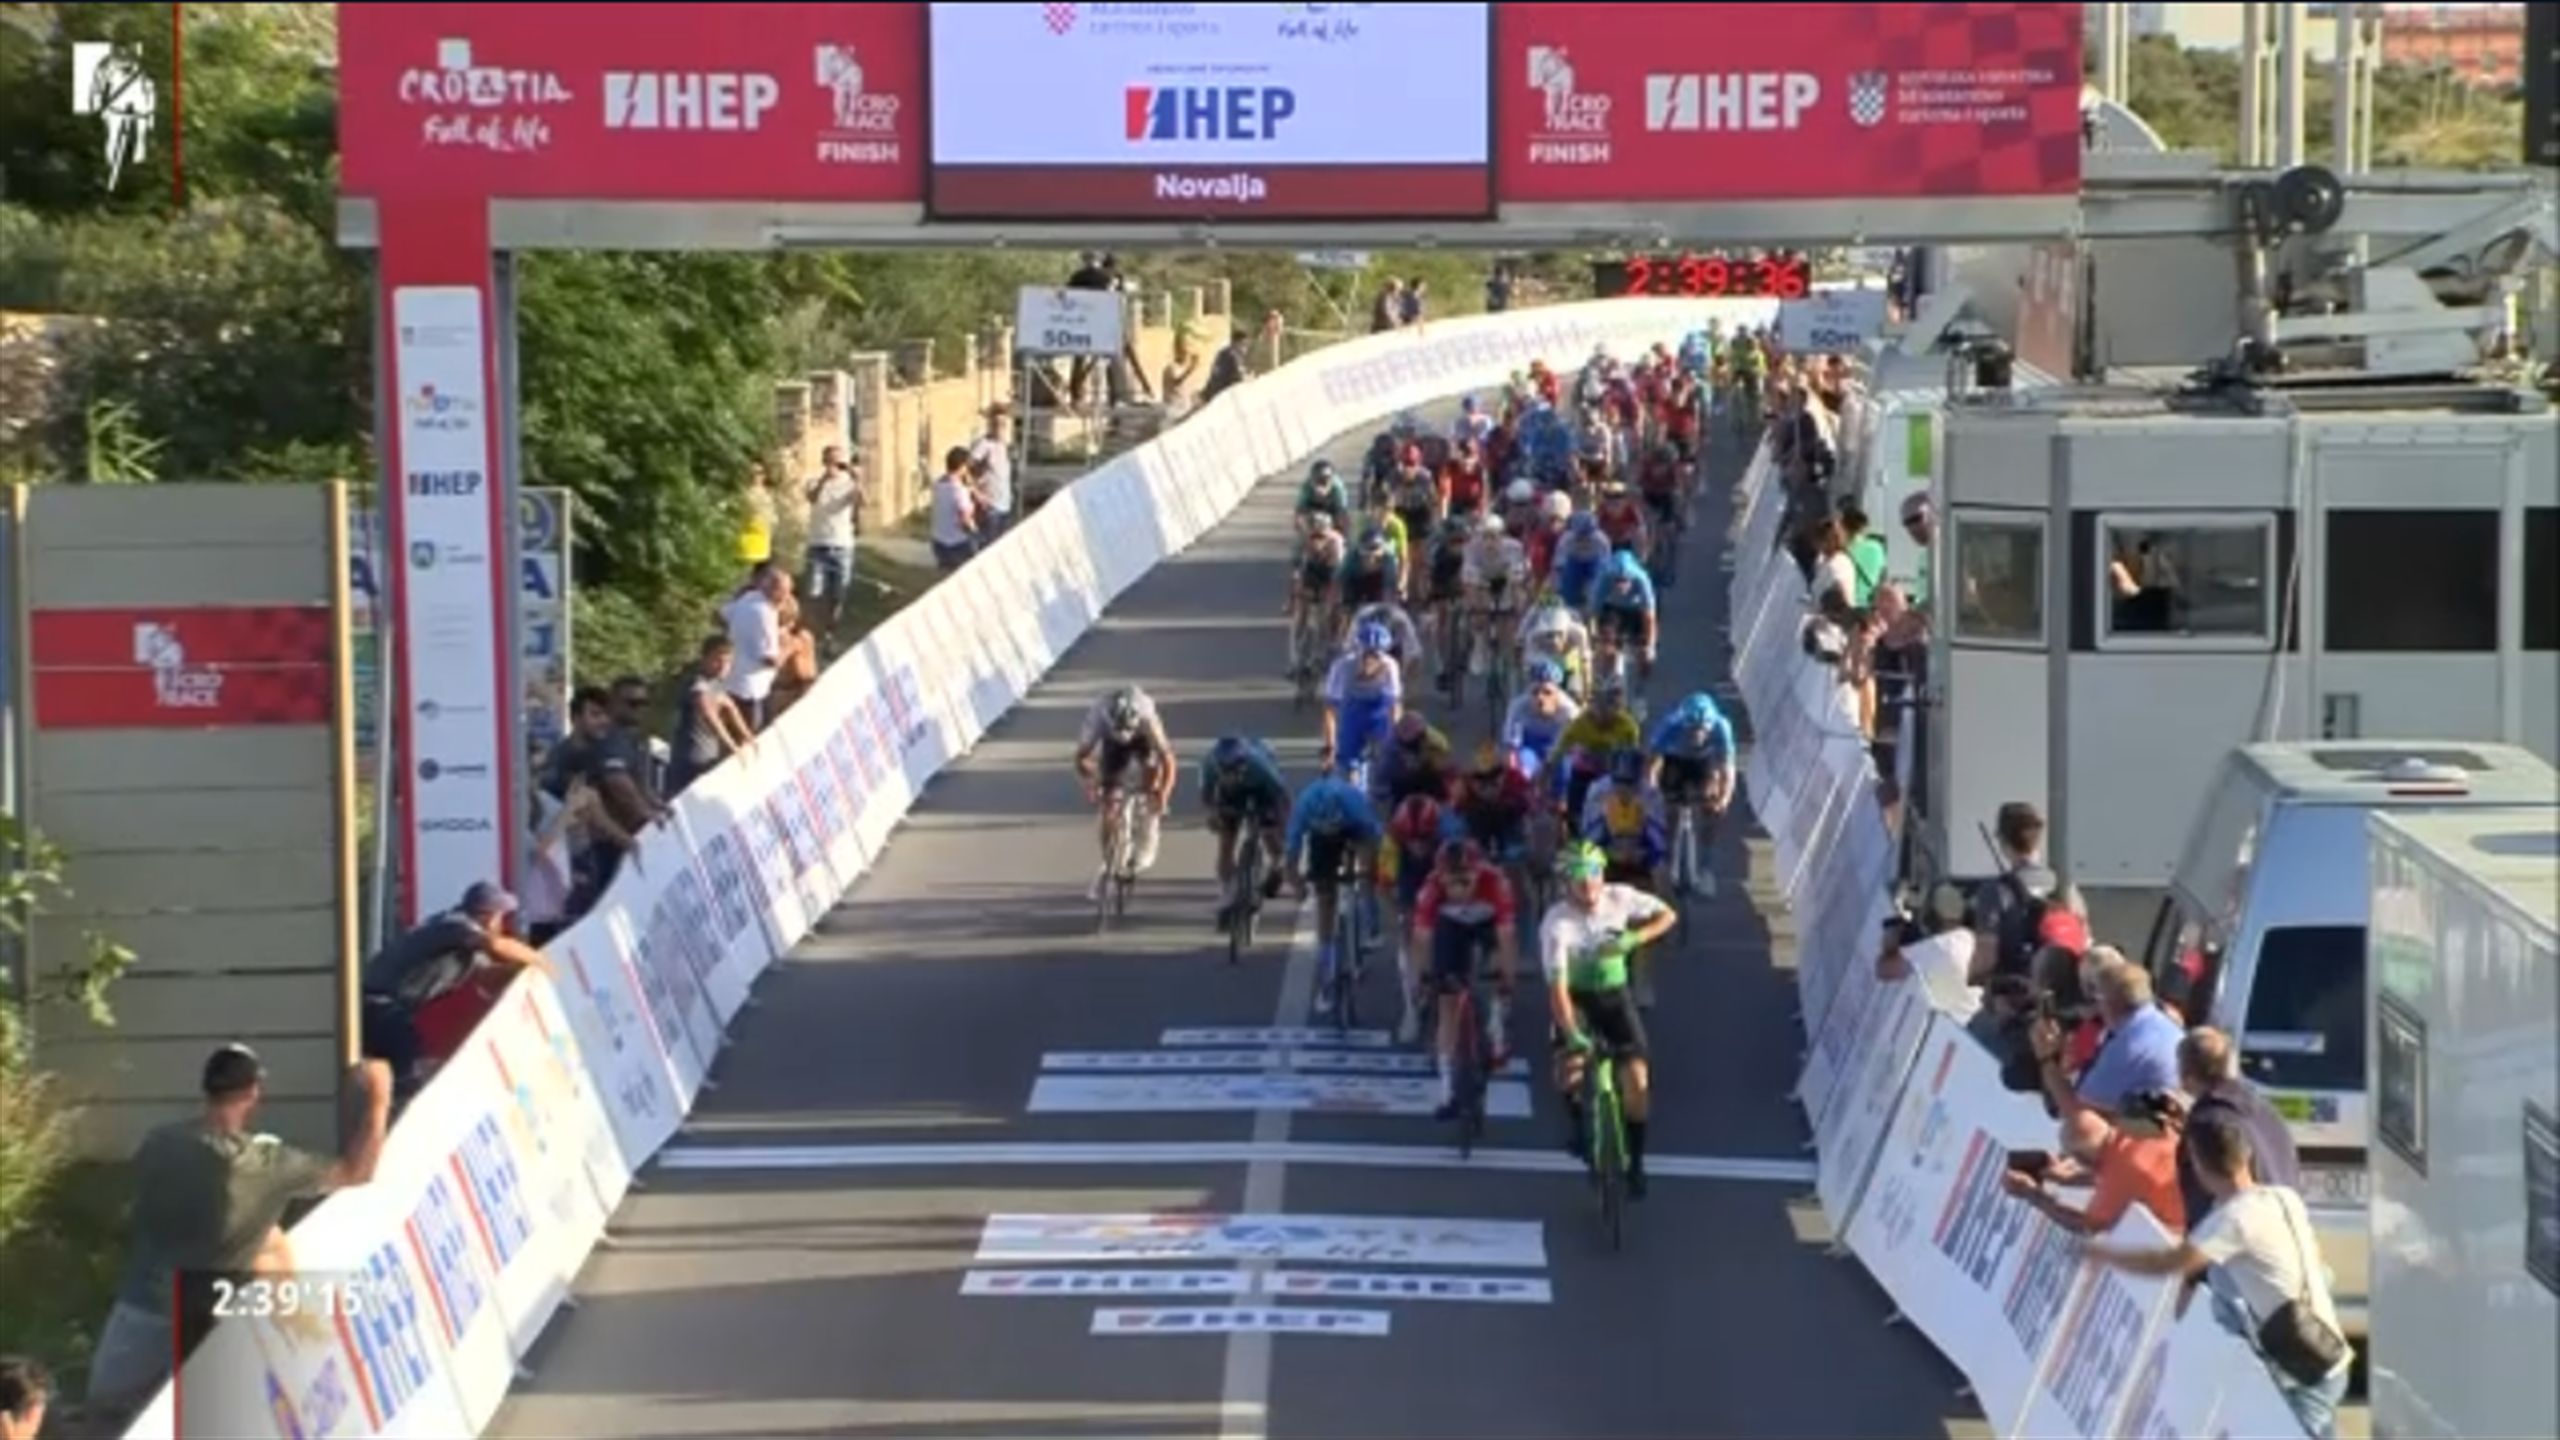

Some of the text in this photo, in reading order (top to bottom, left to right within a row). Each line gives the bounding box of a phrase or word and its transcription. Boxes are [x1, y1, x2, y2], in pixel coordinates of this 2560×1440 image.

[399, 67, 574, 108] CROATIA
[665, 73, 778, 128] HEP
[1704, 73, 1818, 128] HEP
[1184, 87, 1296, 140] HEP
[817, 142, 900, 163] FINISH
[1529, 143, 1610, 163] FINISH
[1155, 173, 1266, 203] Novalja
[1625, 256, 1805, 300] 2:39:36
[1809, 329, 1861, 347] 50m
[434, 472, 483, 496] HEP
